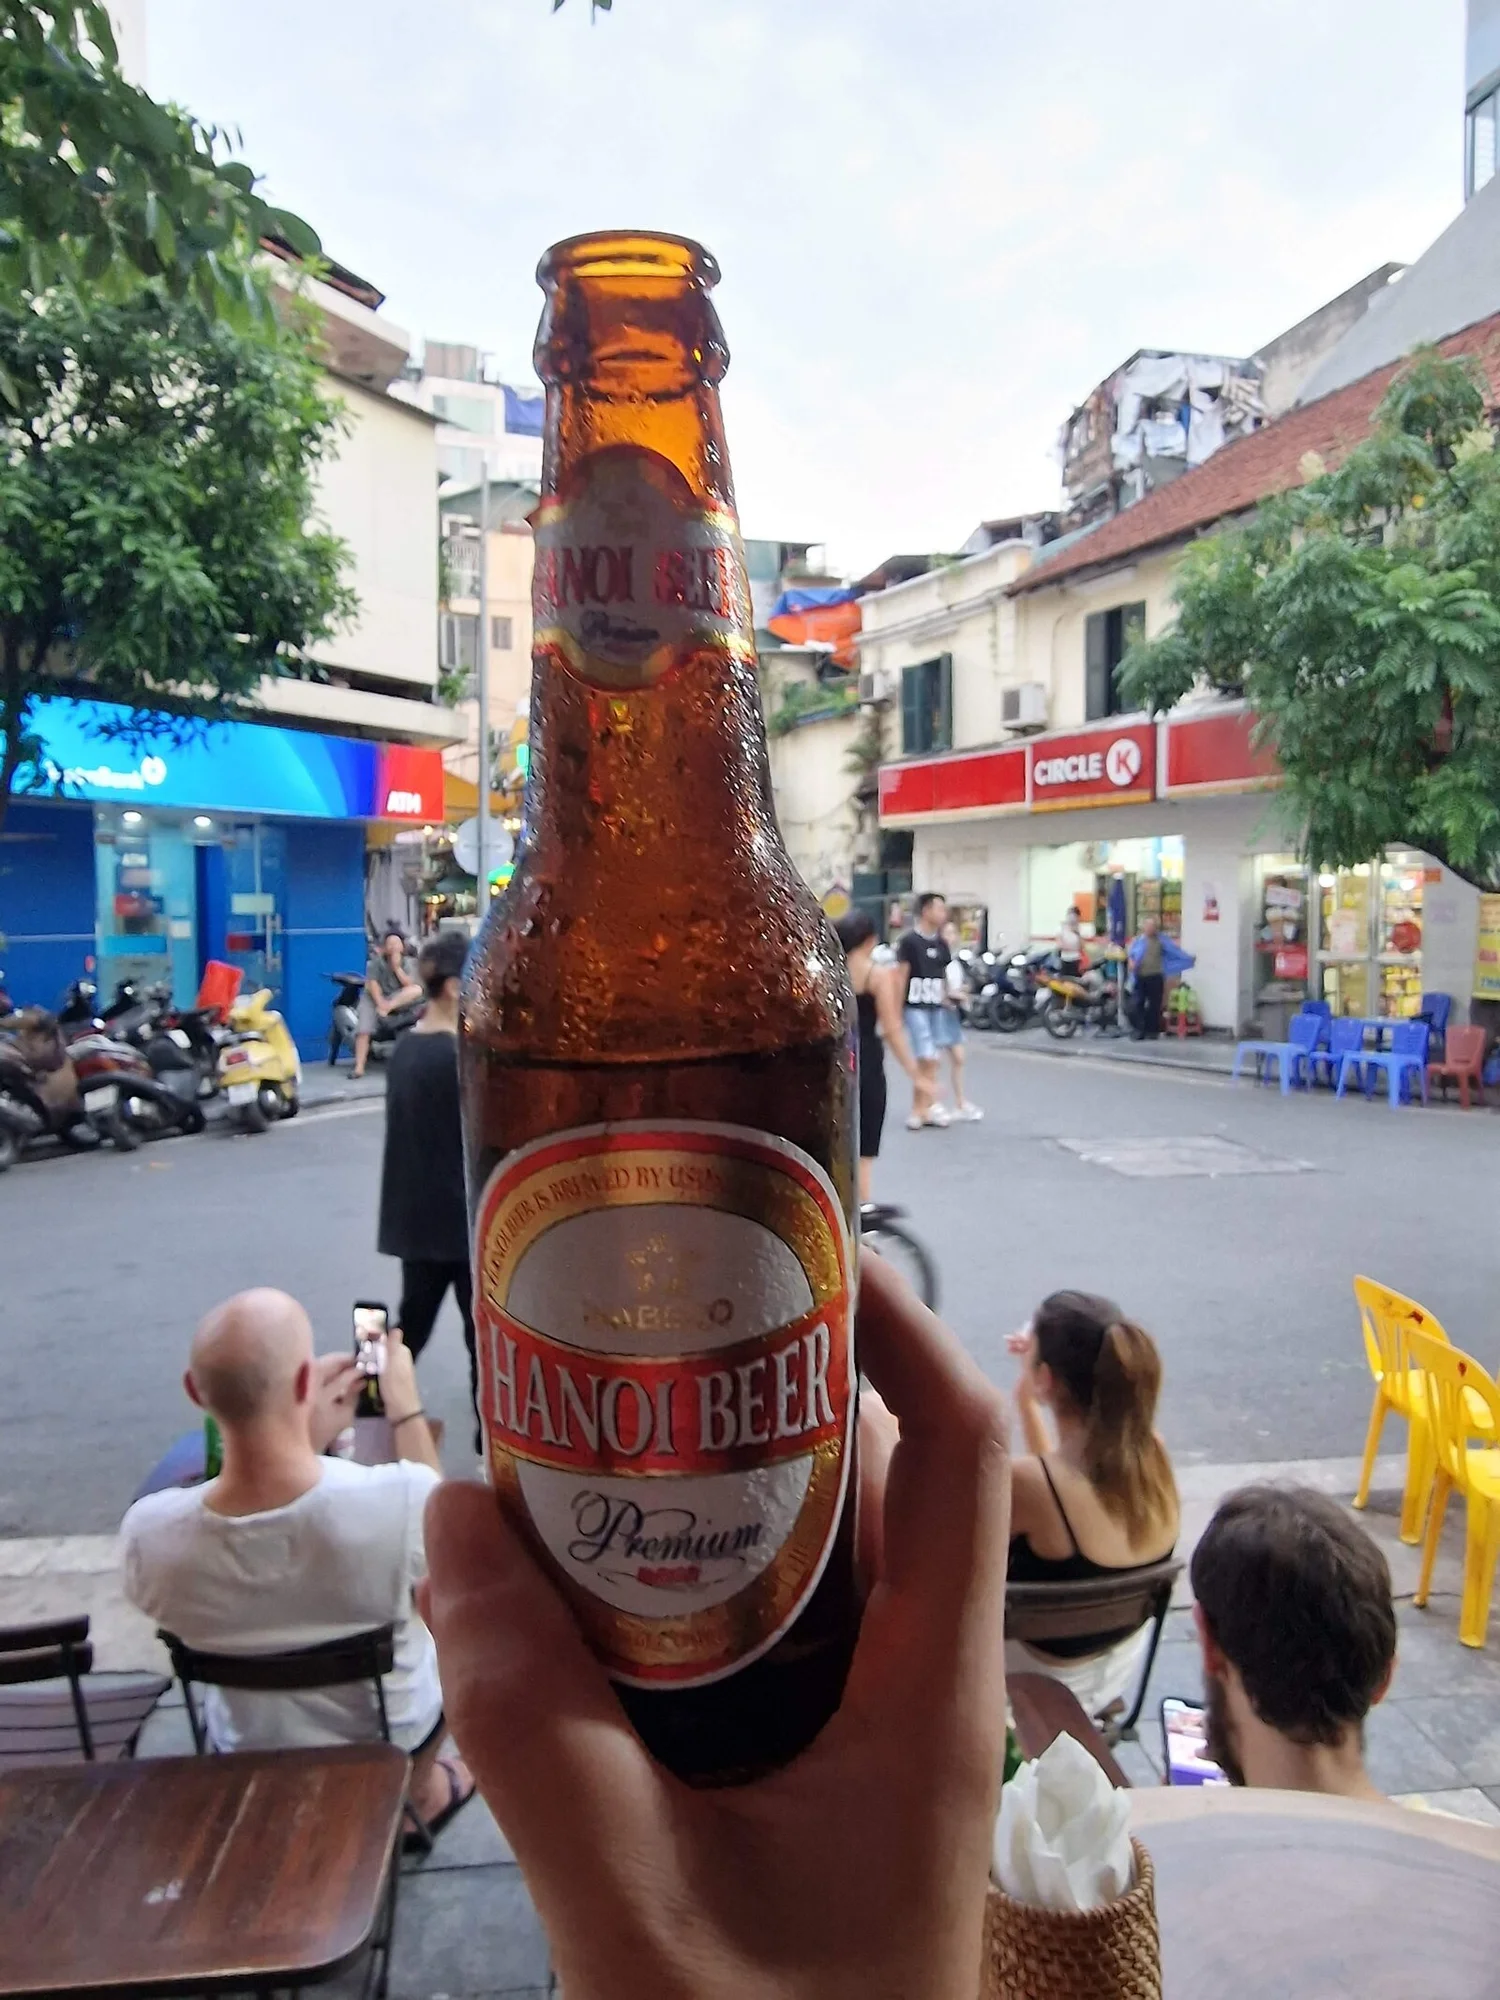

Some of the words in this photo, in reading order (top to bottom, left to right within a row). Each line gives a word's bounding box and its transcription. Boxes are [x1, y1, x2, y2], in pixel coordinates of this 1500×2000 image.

[1034, 752, 1104, 786] CIRCLE
[386, 790, 422, 814] ATM
[635, 1165, 664, 1189] BY
[489, 1321, 676, 1456] HANOI
[696, 1321, 836, 1452] BEER
[567, 1489, 763, 1562] Premium
